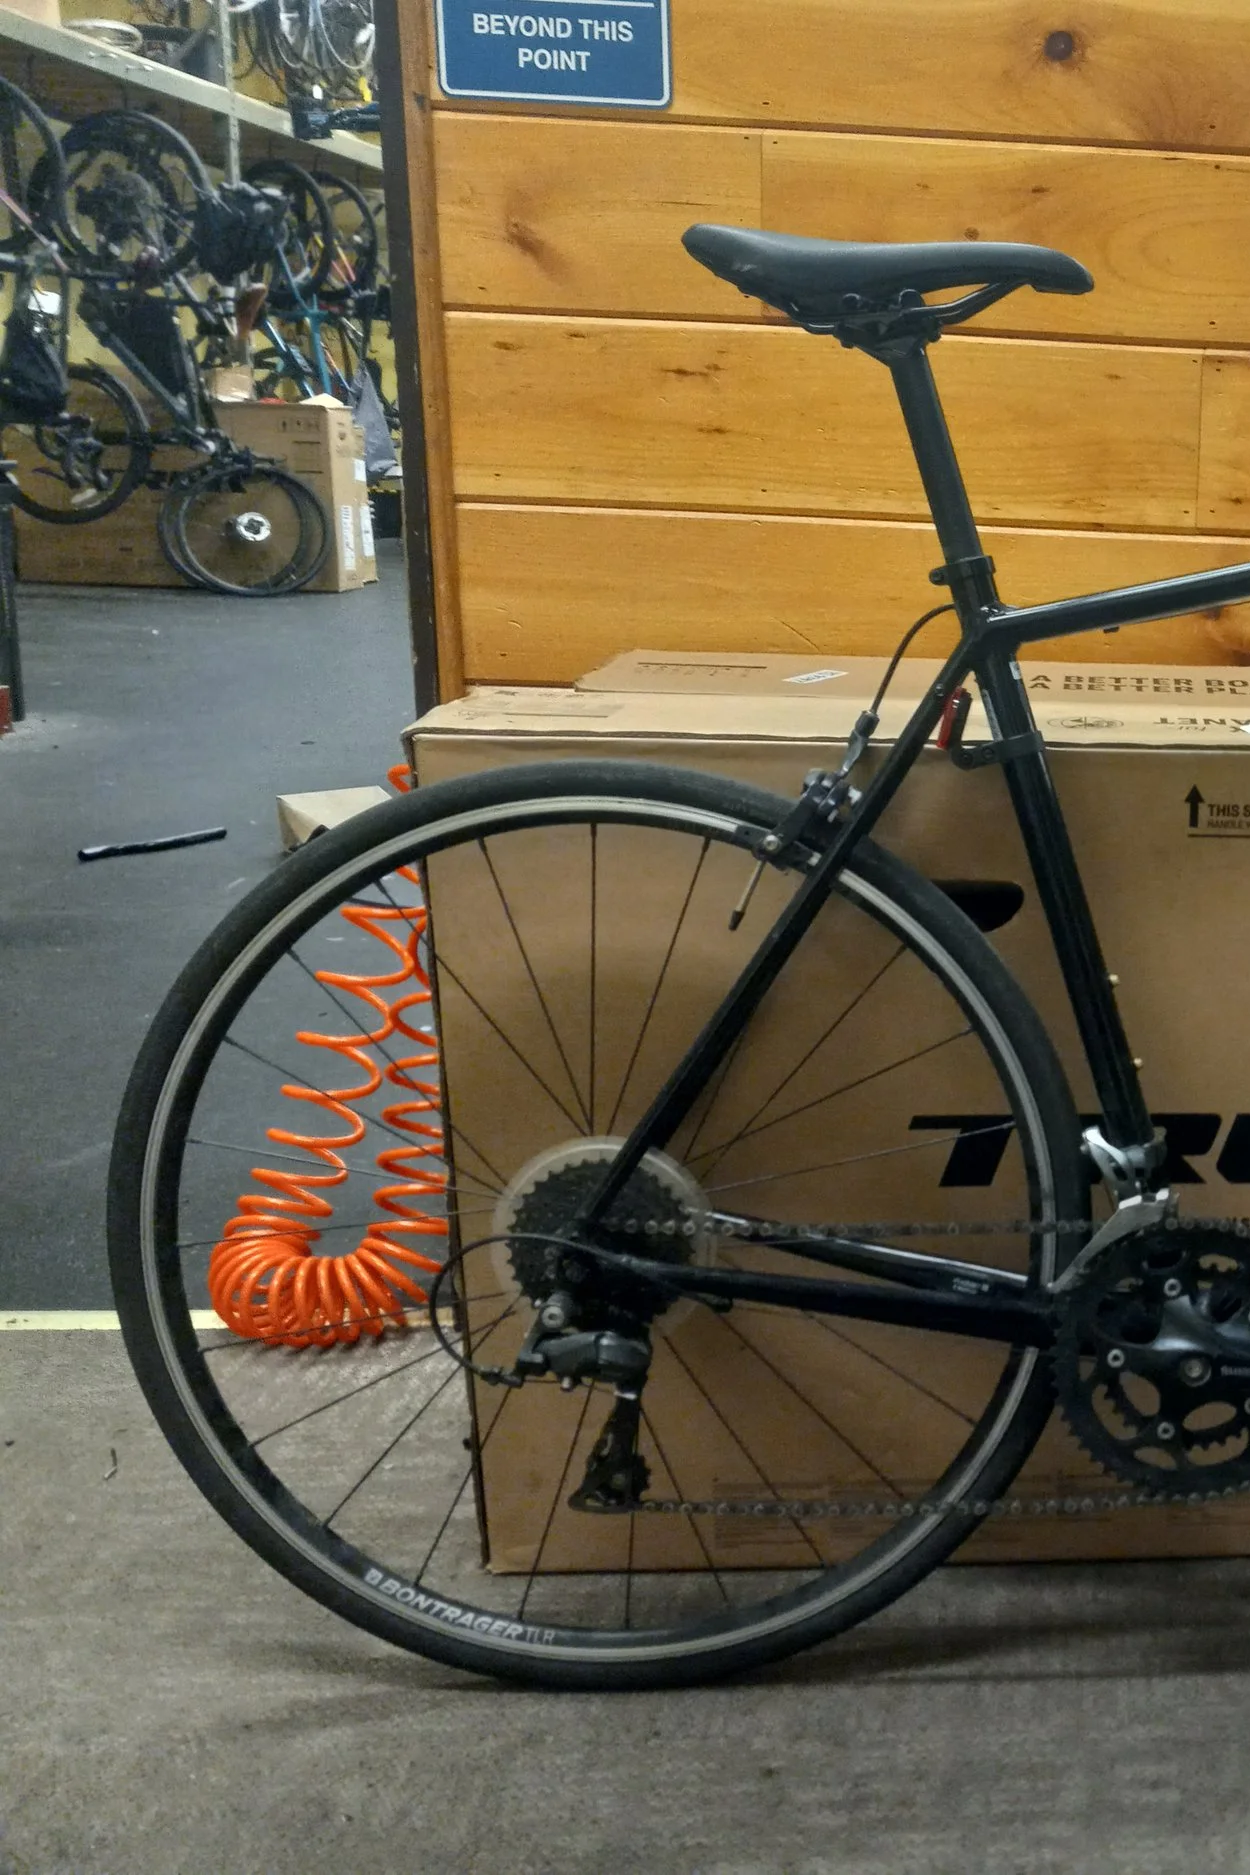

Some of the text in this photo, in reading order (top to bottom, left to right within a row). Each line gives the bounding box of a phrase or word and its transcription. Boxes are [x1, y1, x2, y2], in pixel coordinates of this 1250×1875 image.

[472, 13, 634, 42] BEYOND THIS
[518, 48, 591, 72] POINT
[1028, 682, 1051, 690] A
[1063, 683, 1194, 694] BETTER
[1030, 674, 1052, 682] A
[1064, 675, 1194, 686] BETTER
[1207, 803, 1240, 818] THIS
[379, 1579, 556, 1645] BONTRAGER TLR
